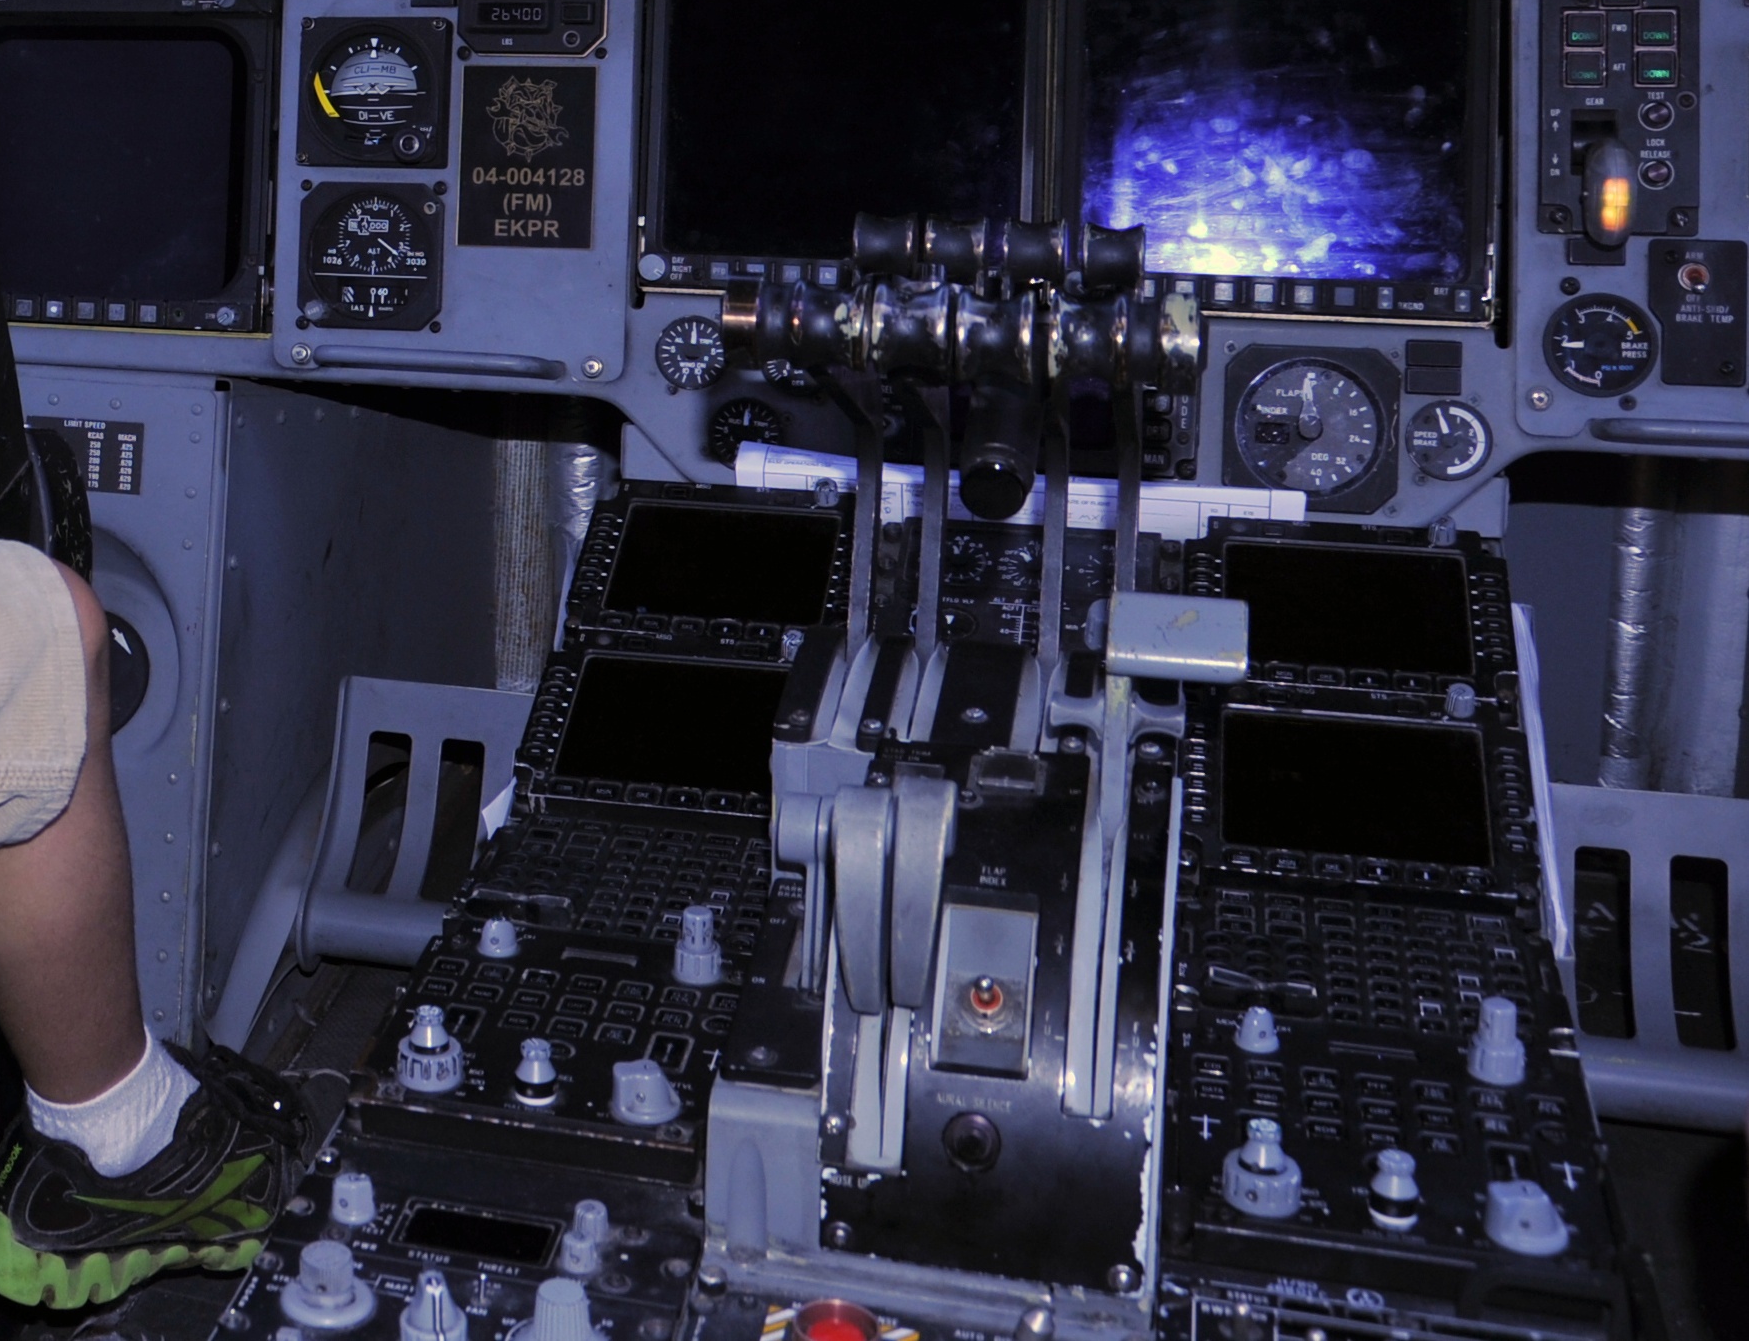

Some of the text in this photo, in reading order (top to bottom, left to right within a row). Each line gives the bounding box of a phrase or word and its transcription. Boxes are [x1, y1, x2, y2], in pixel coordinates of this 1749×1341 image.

[492, 8, 541, 21] 26400
[1572, 32, 1598, 40] DOWN
[1643, 70, 1669, 78] DOWN
[1640, 150, 1671, 158] RELEASE
[473, 167, 585, 186] 04-004128
[503, 193, 552, 216] (FM)
[494, 219, 559, 238] EKPR
[323, 257, 342, 265] 1026
[672, 265, 692, 273] NIGHT
[1676, 314, 1734, 323] BRAKE TEMP
[1621, 342, 1648, 350] BRAKE
[85, 421, 106, 429] SPEED
[1413, 438, 1438, 447] BRAKE
[1144, 454, 1164, 464] MAN
[1311, 453, 1329, 461] DEG
[1310, 468, 1322, 476] 40
[981, 866, 1006, 875] FLAP
[979, 876, 1007, 886] INDEX
[936, 1093, 1011, 1110] AURAL SILENCE
[408, 1251, 450, 1263] STATUS
[478, 1262, 520, 1275] THREAT
